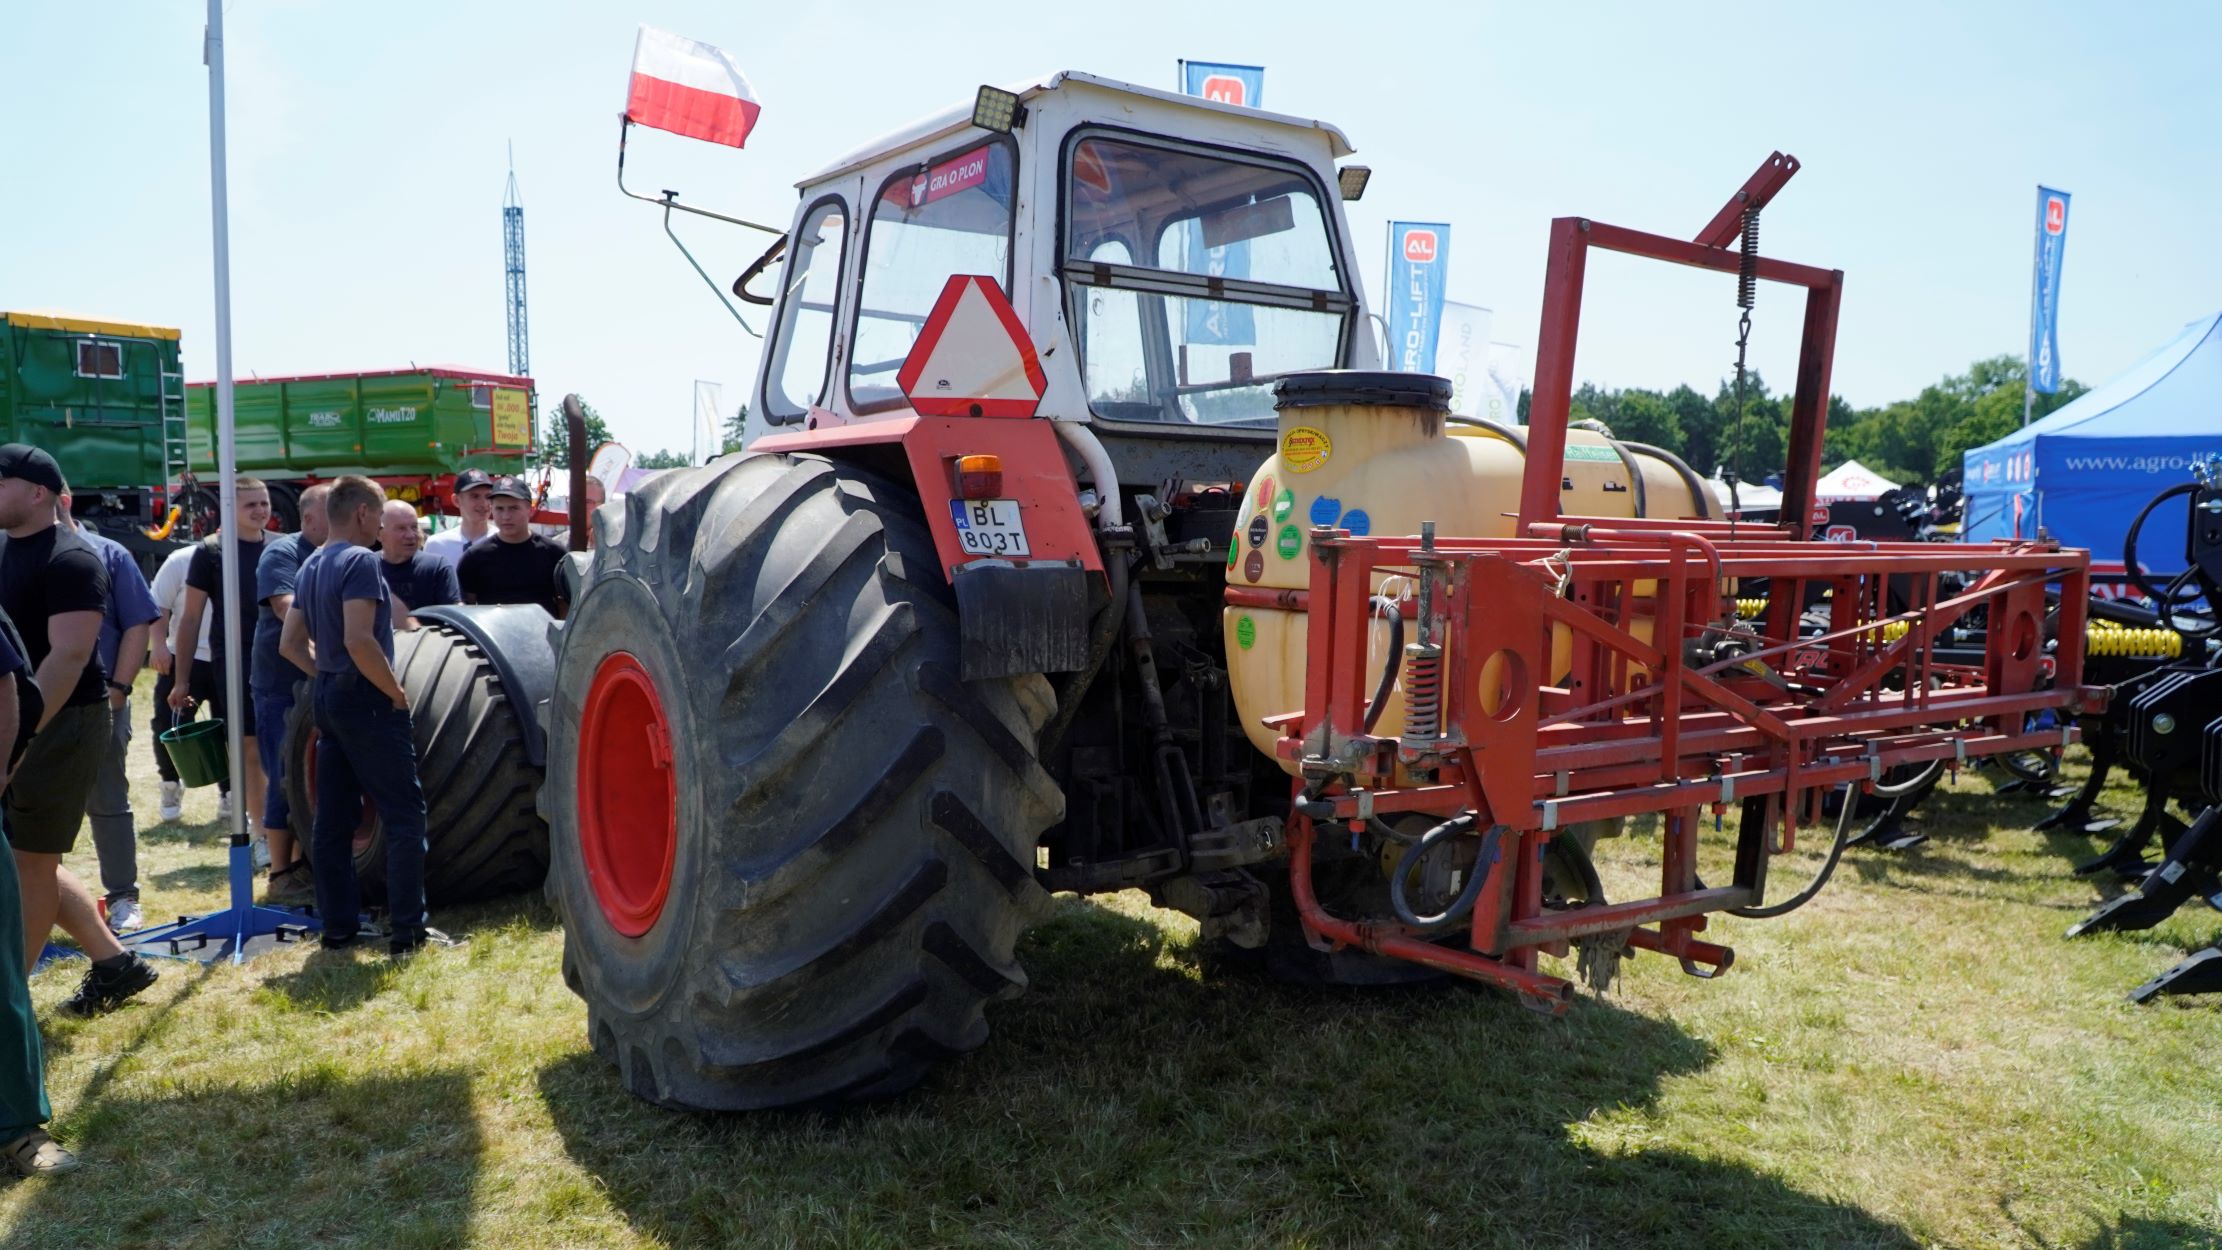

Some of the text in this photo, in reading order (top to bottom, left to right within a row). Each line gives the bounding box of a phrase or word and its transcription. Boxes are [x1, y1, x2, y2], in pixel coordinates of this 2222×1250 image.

[930, 159, 984, 192] GRA O PLON
[1407, 240, 1433, 255] AL
[956, 518, 969, 527] PL
[973, 506, 1005, 526] BL
[965, 531, 1020, 551] 803T
